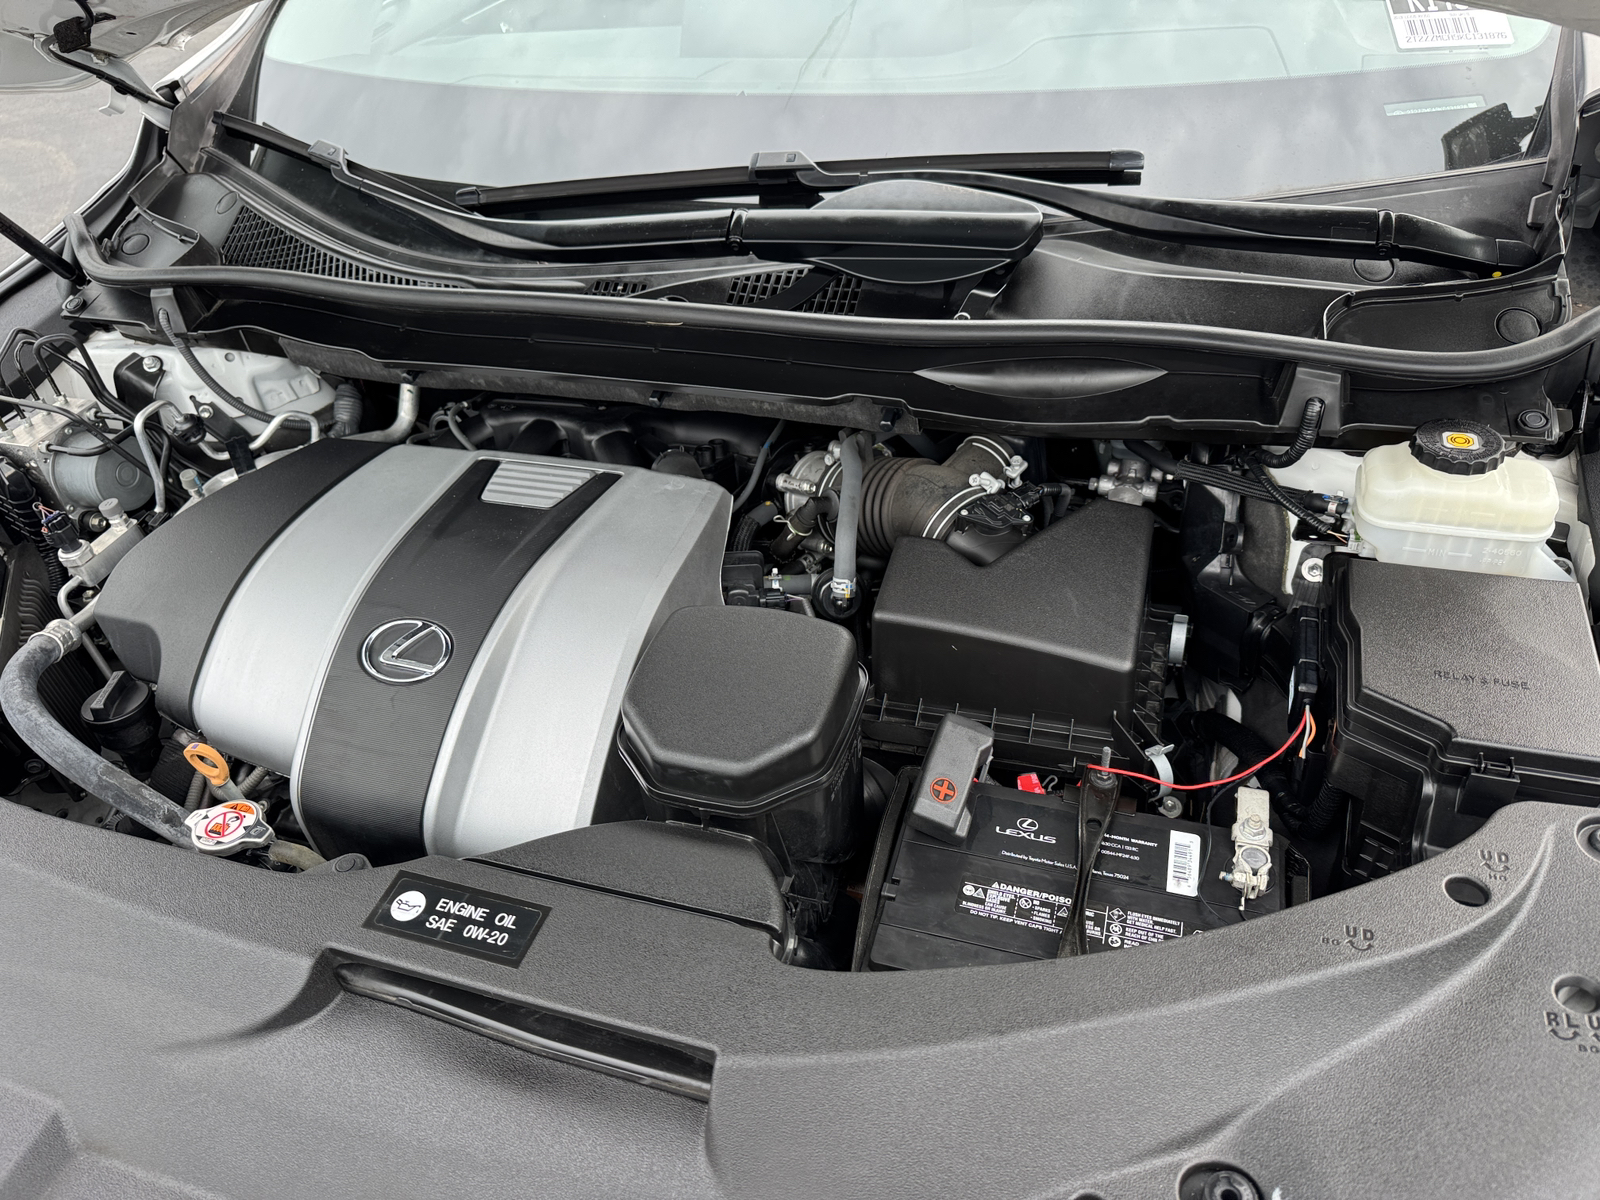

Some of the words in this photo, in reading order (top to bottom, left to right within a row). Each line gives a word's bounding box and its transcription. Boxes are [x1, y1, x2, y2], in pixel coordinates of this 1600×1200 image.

[1428, 548, 1446, 557] MIN
[1433, 669, 1476, 684] RELAY
[1493, 678, 1530, 690] FUSE
[996, 826, 1056, 844] LEXUS
[1131, 838, 1158, 847] WARRANTY
[1000, 882, 1072, 904] DANGER/POISO
[436, 898, 490, 922] ENGINE
[494, 912, 517, 929] OIL
[426, 914, 458, 932] SAE
[462, 924, 509, 946] 0W-20
[1028, 922, 1042, 930] CAPS
[1043, 926, 1060, 934] TIGHT
